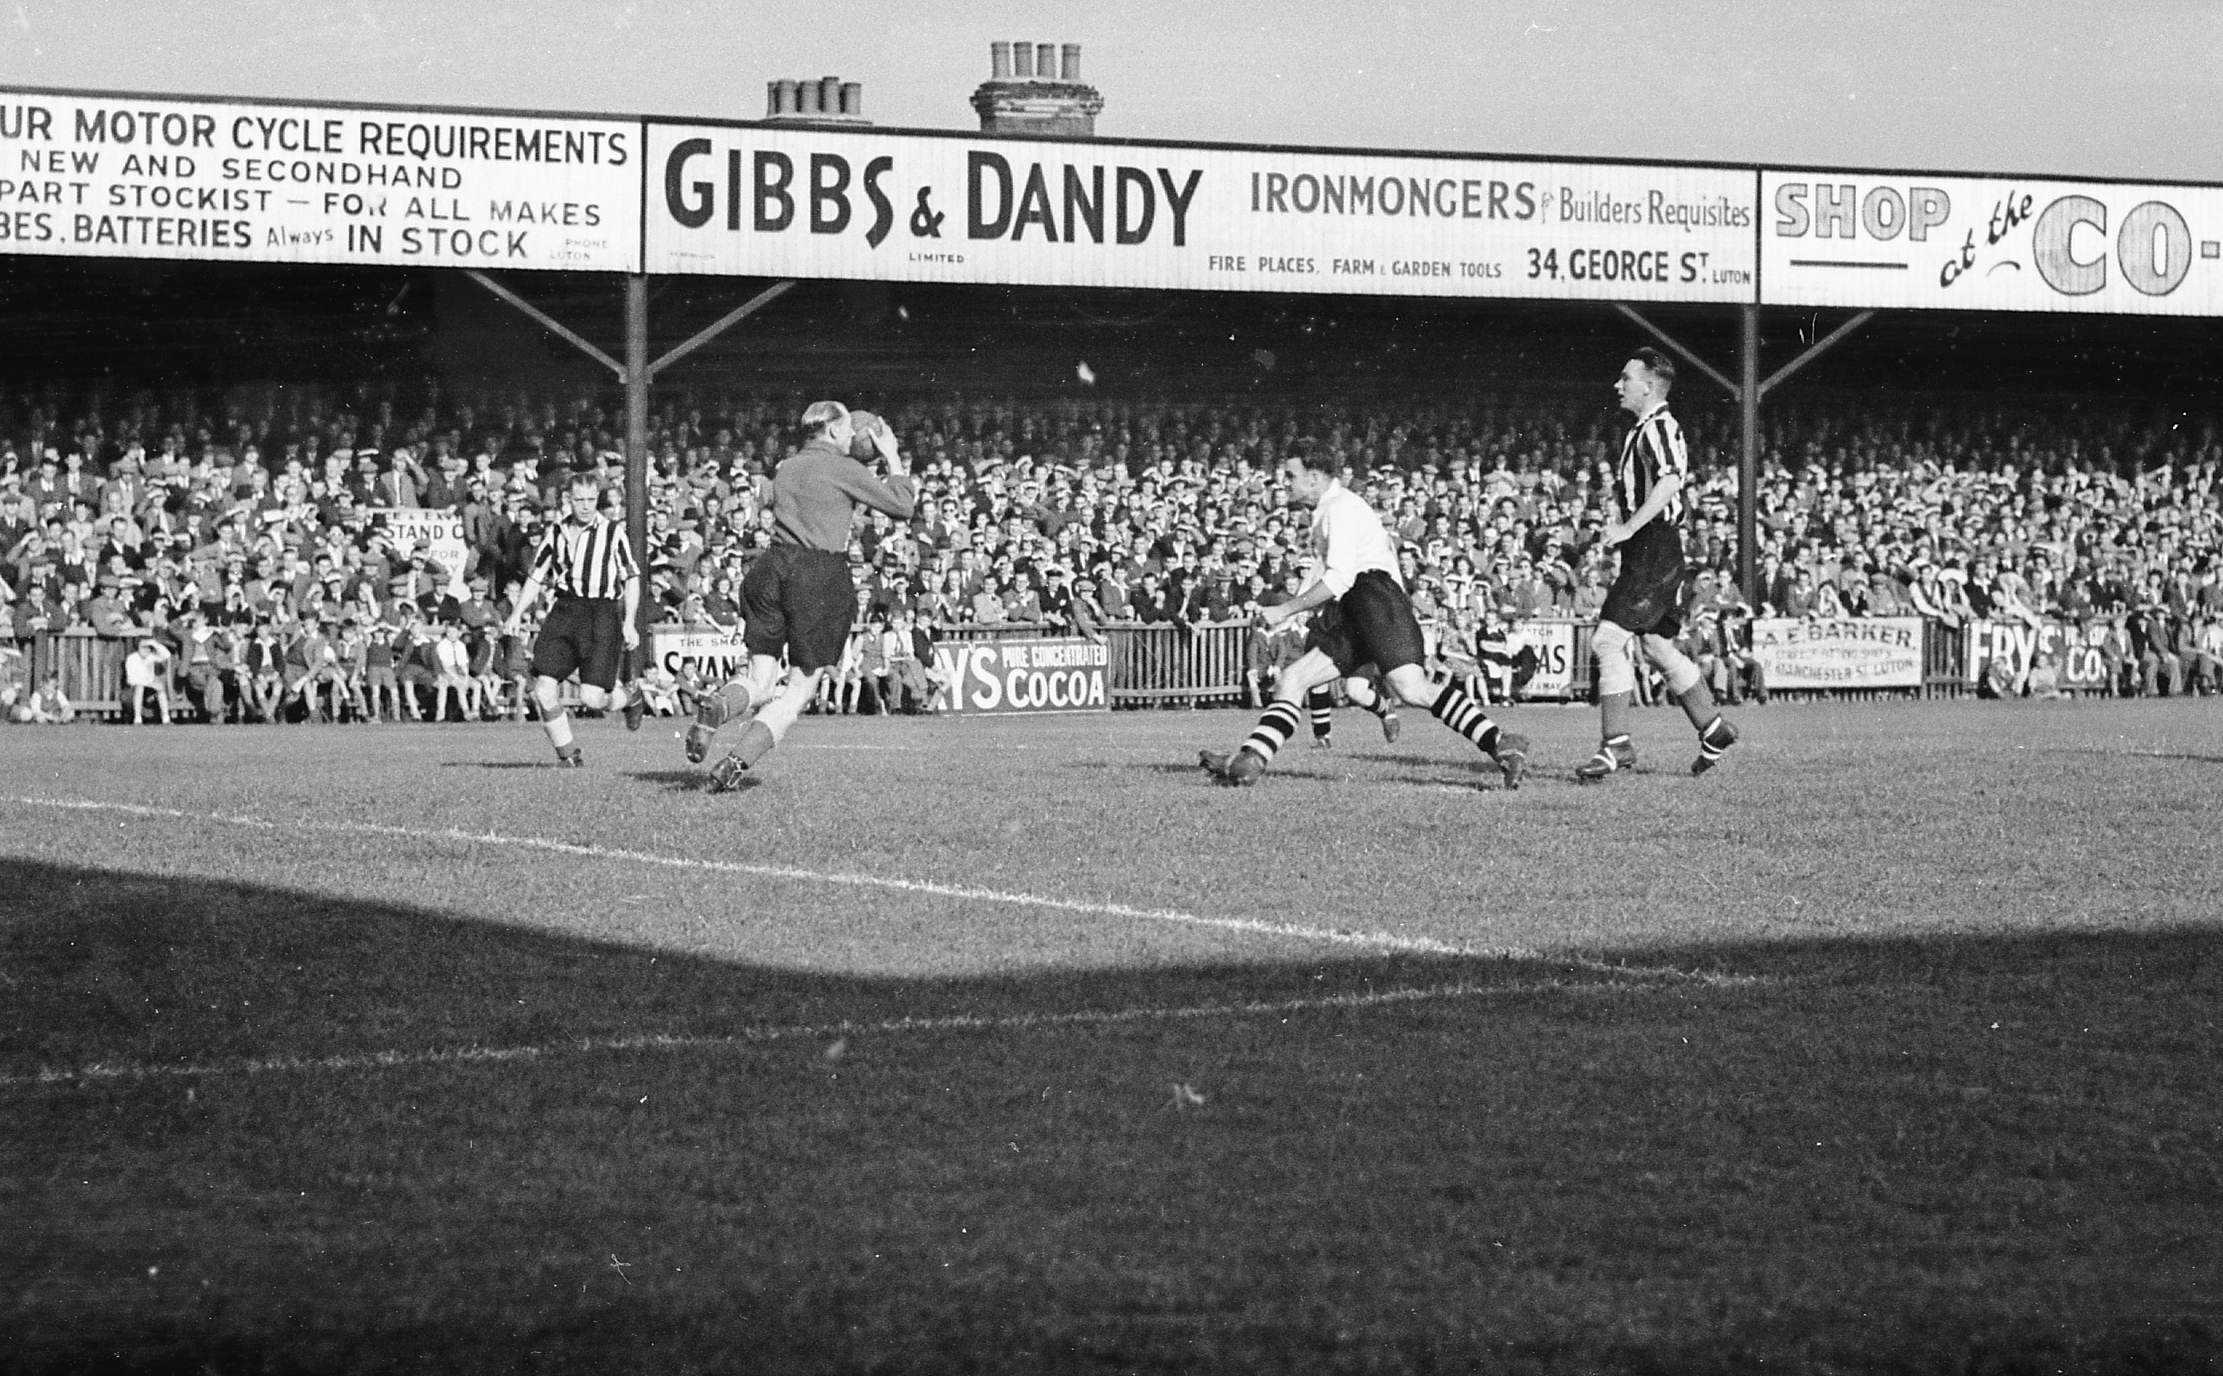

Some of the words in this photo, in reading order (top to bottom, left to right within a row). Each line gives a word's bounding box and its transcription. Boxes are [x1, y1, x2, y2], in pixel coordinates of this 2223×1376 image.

[0, 105, 52, 140] UR
[75, 109, 215, 148] MOTOR
[232, 117, 343, 153] CYCLE
[358, 121, 628, 166] REQUIREMENTS
[22, 150, 99, 173] NEW
[122, 154, 195, 177] AND
[222, 158, 462, 189] SECONDHAND
[0, 180, 89, 204] PART
[109, 184, 272, 211] STOCKIST
[406, 197, 469, 221] ALL
[491, 201, 600, 226] MAKES
[665, 137, 893, 250] GIBBS
[910, 186, 945, 238] &
[968, 150, 1203, 247] DANDY
[1252, 172, 1535, 220] IRONMONGERS
[1560, 187, 1641, 223] Builders
[1648, 190, 1750, 233] Requisites
[75, 214, 251, 248] BATTERIES
[267, 226, 333, 246] Always
[349, 225, 381, 253] IN
[402, 227, 527, 257] STOCK
[1775, 183, 1951, 242] SHOP
[1940, 228, 1975, 288] at
[1986, 190, 2033, 245] the
[909, 253, 964, 263] LIMITED
[1209, 256, 1246, 271] FIRE
[1333, 259, 1374, 274] FARM
[1392, 261, 1450, 276] GARDEN
[1460, 262, 1501, 278] TOOLS
[1569, 249, 1668, 282] GEORGE
[1713, 270, 1750, 284] LUTON
[681, 638, 703, 647] THE
[1002, 646, 1029, 668] PURE
[1031, 645, 1107, 668] CONCENTRATED
[1006, 668, 1105, 708] COCOA
